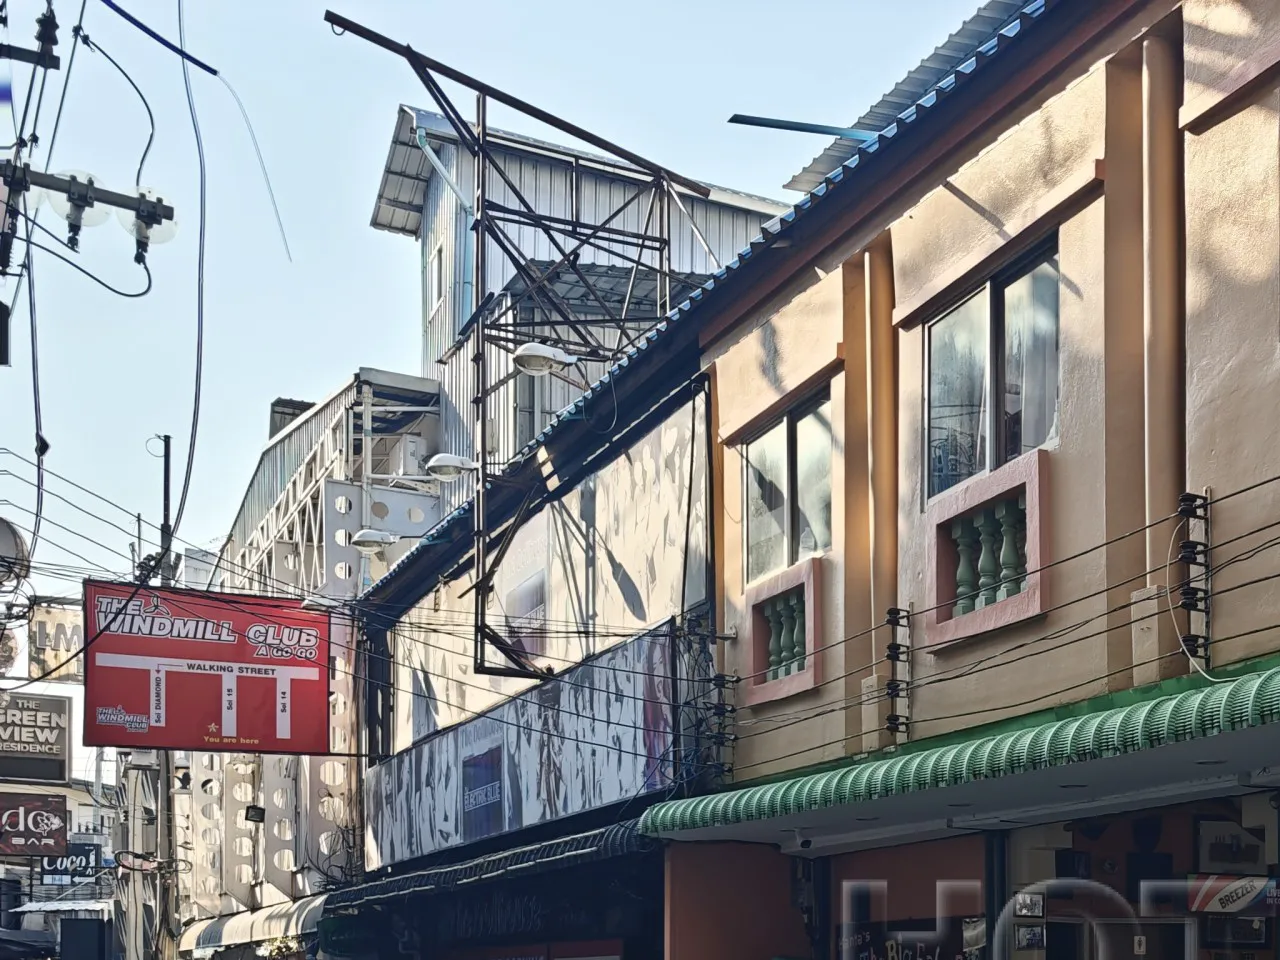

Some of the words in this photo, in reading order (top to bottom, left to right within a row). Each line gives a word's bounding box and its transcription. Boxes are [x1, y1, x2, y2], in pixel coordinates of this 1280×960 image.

[96, 596, 142, 615] THE
[96, 611, 238, 644] WINDMILL
[247, 622, 320, 648] CLUB
[254, 645, 270, 659] A
[271, 646, 293, 660] GO
[295, 647, 318, 660] GO
[186, 663, 234, 674] WALKING
[237, 666, 277, 676] STREET
[154, 676, 162, 711] DIAMOND
[226, 688, 233, 697] 15
[280, 691, 287, 701] 14
[16, 699, 40, 709] THE
[280, 701, 288, 713] Soi
[97, 713, 148, 723] WINDMILL
[154, 711, 162, 724] Soi
[0, 726, 59, 743] VIEW
[204, 735, 220, 744] You
[240, 737, 259, 745] here
[12, 837, 55, 846] BAR
[1218, 881, 1257, 909] BREEZER
[1266, 897, 1274, 906] IN
